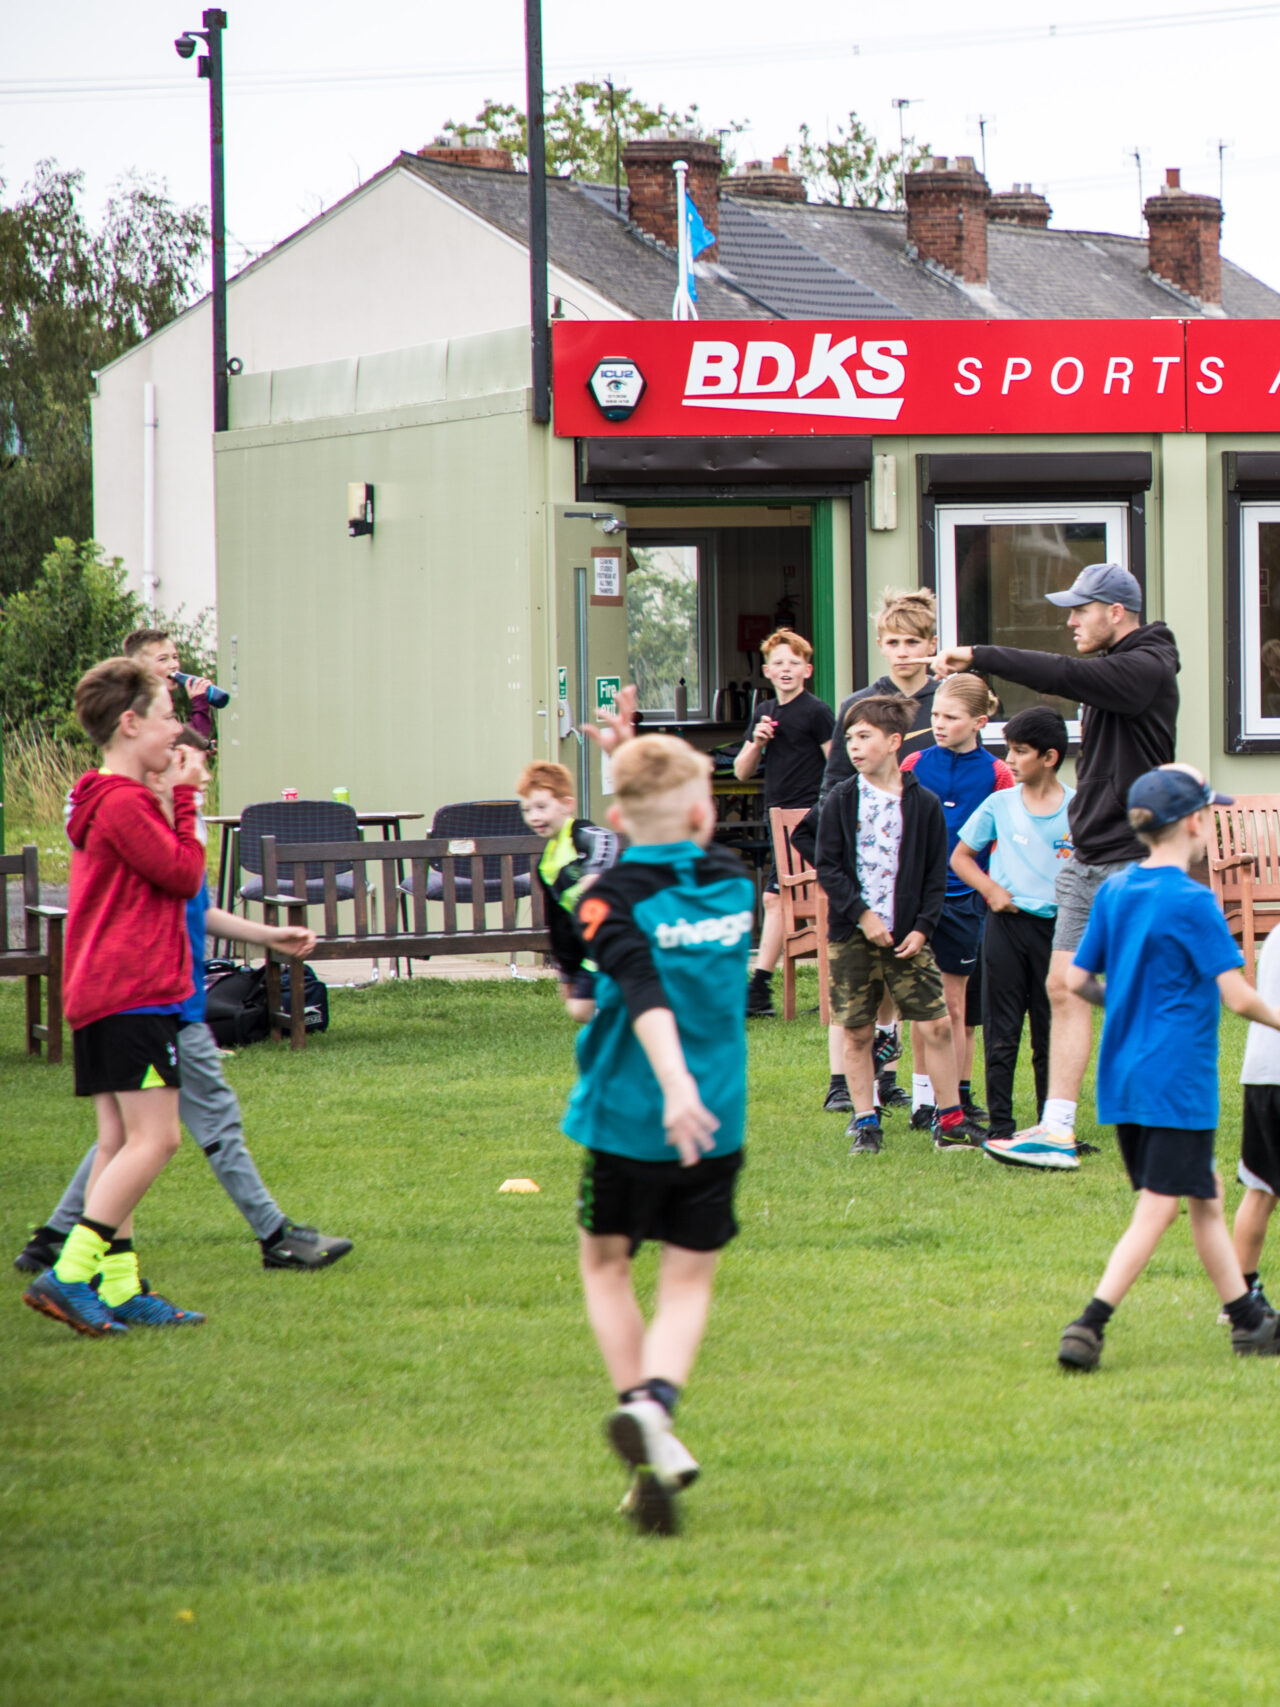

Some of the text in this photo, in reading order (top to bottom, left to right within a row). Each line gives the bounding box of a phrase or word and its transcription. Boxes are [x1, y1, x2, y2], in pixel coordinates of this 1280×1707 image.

[601, 370, 634, 378] ICU2
[684, 333, 907, 398] BDKS
[954, 356, 1224, 395] SPORTS
[601, 681, 617, 699] Fire
